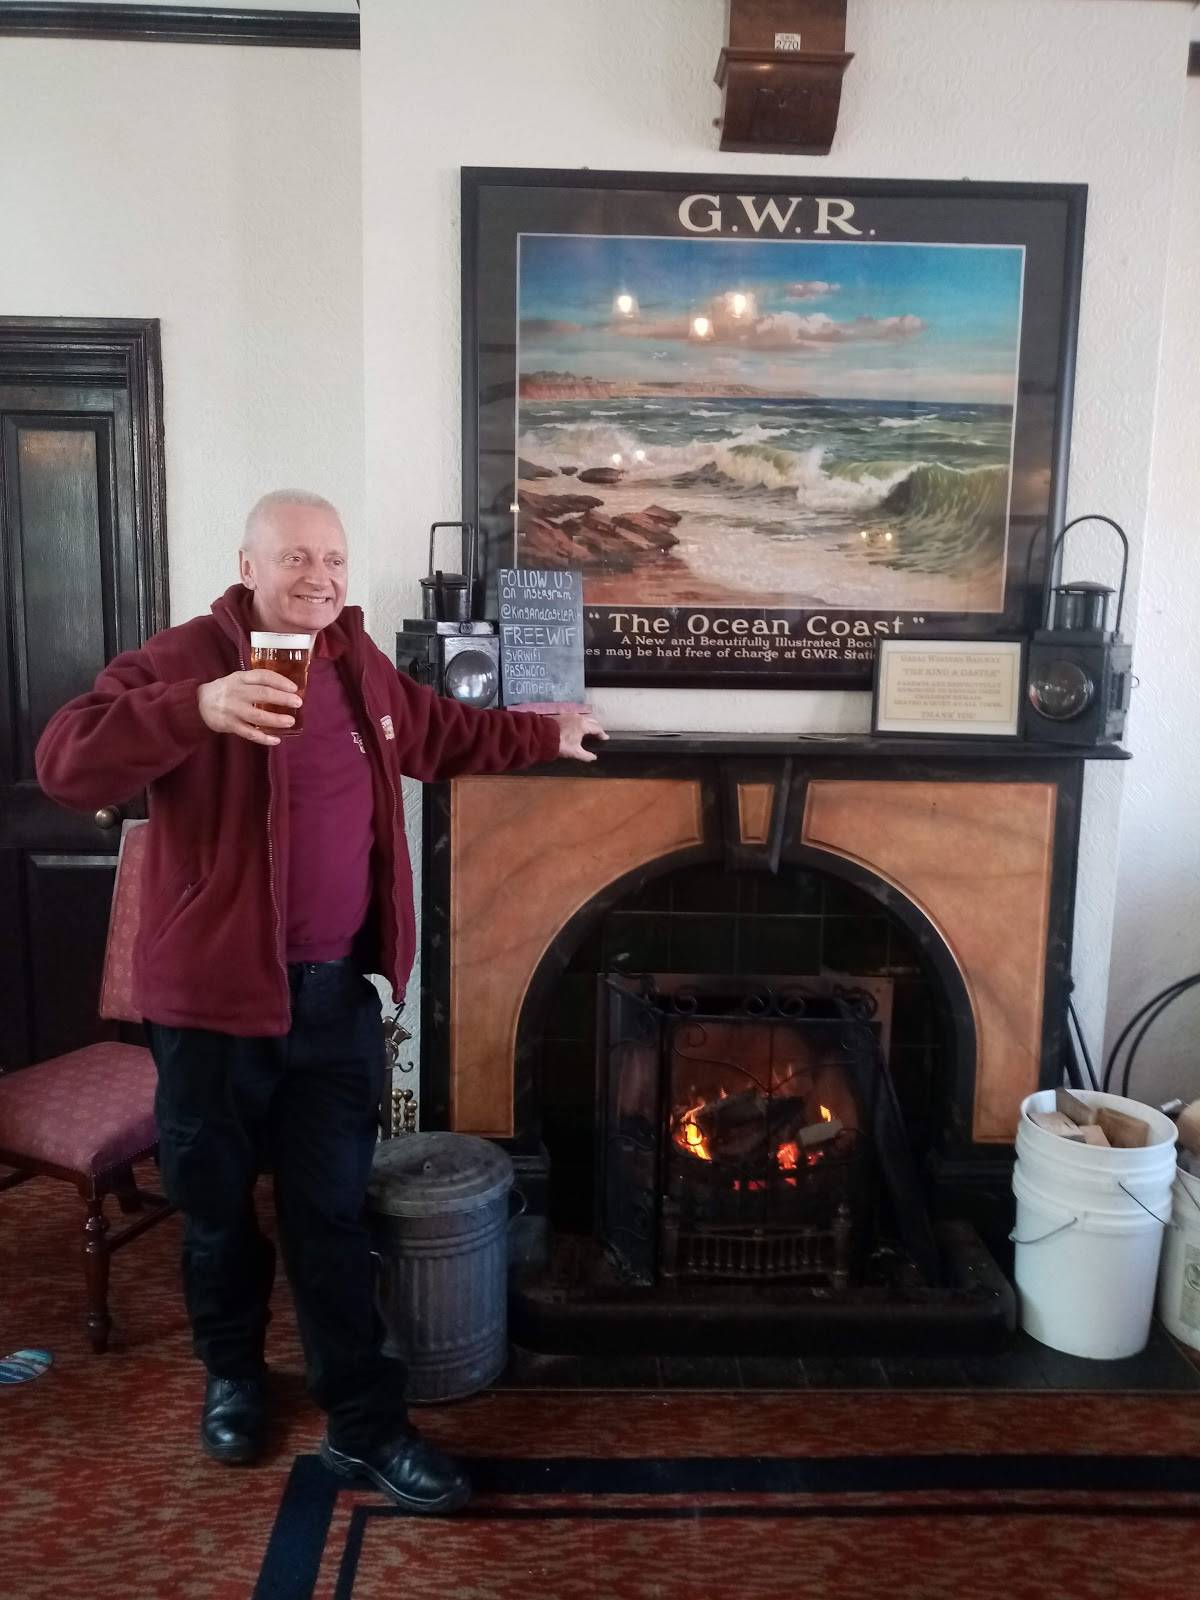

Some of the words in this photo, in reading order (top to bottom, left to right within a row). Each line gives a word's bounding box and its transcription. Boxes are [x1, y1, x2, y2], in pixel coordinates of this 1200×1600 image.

[678, 193, 876, 235] G.W.R.
[500, 569, 548, 588] FOLLOW
[553, 571, 573, 590] US
[687, 614, 791, 635] Ocean
[503, 626, 544, 645] FREE
[621, 635, 631, 645] A
[635, 636, 665, 645] New
[671, 636, 695, 646] and
[700, 636, 769, 650] Beautifully
[775, 637, 840, 648] Illustrated
[847, 638, 876, 648] Boo
[606, 649, 632, 659] may
[637, 647, 652, 657] be
[657, 647, 681, 657] had
[685, 648, 711, 658] free
[716, 648, 731, 658] of
[734, 648, 778, 661] charge
[784, 649, 796, 658] at
[844, 649, 876, 660] Stati
